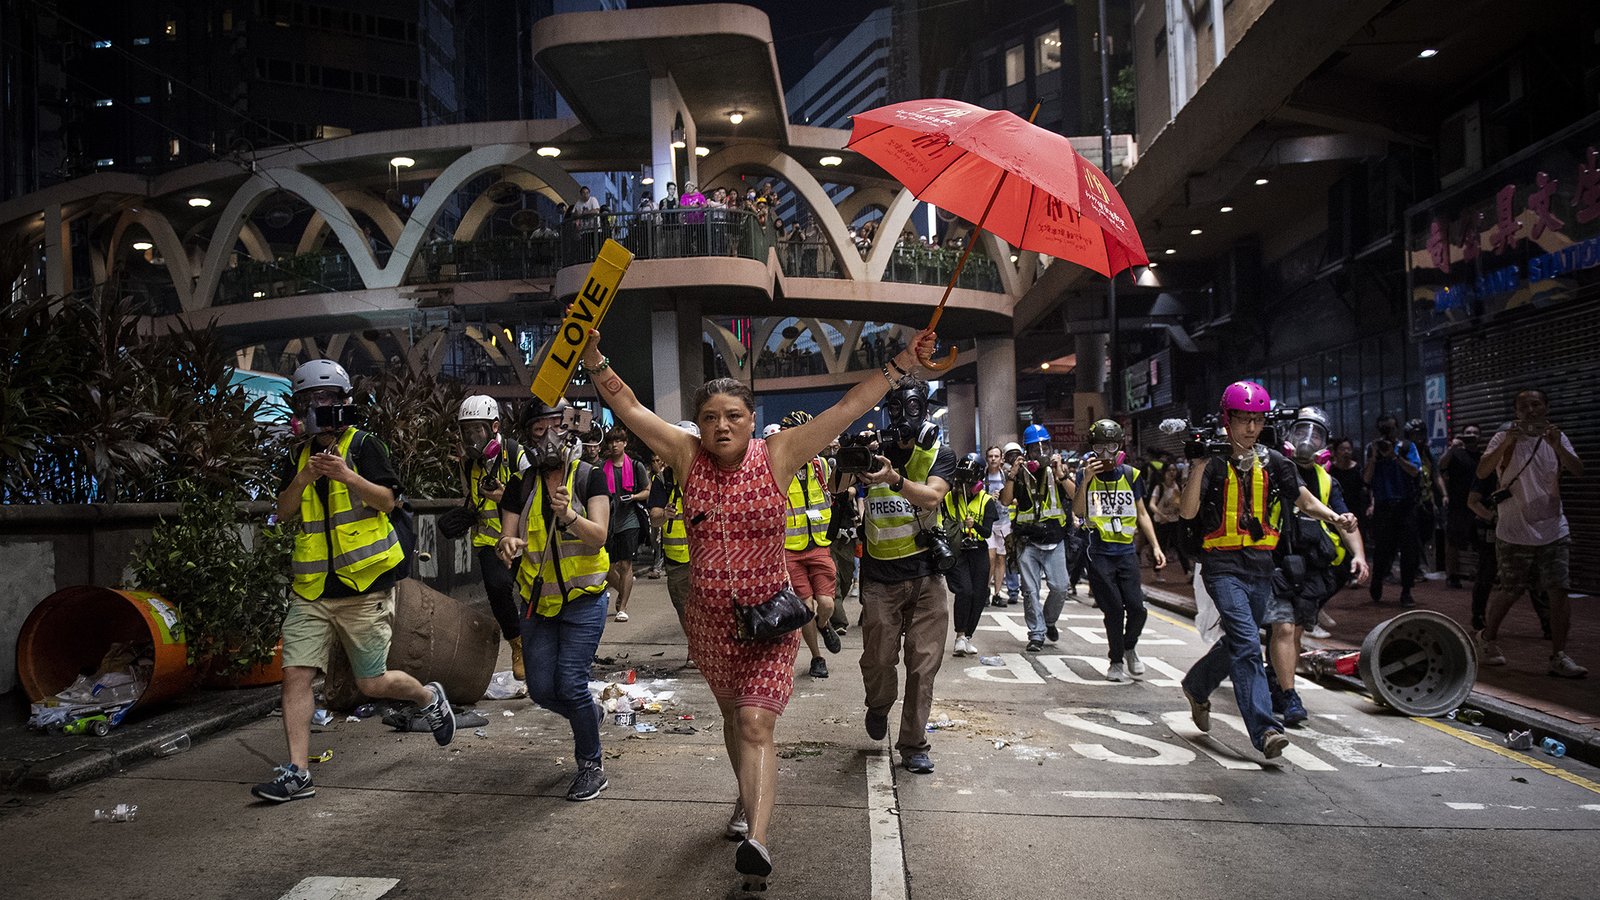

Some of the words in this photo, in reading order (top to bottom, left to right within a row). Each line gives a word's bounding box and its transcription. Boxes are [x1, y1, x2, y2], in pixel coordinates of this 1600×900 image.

[551, 277, 608, 370] LOVE
[462, 408, 480, 416] Press
[1091, 493, 1132, 505] PRESS
[870, 501, 903, 514] PRESS
[964, 652, 1324, 689] TOP
